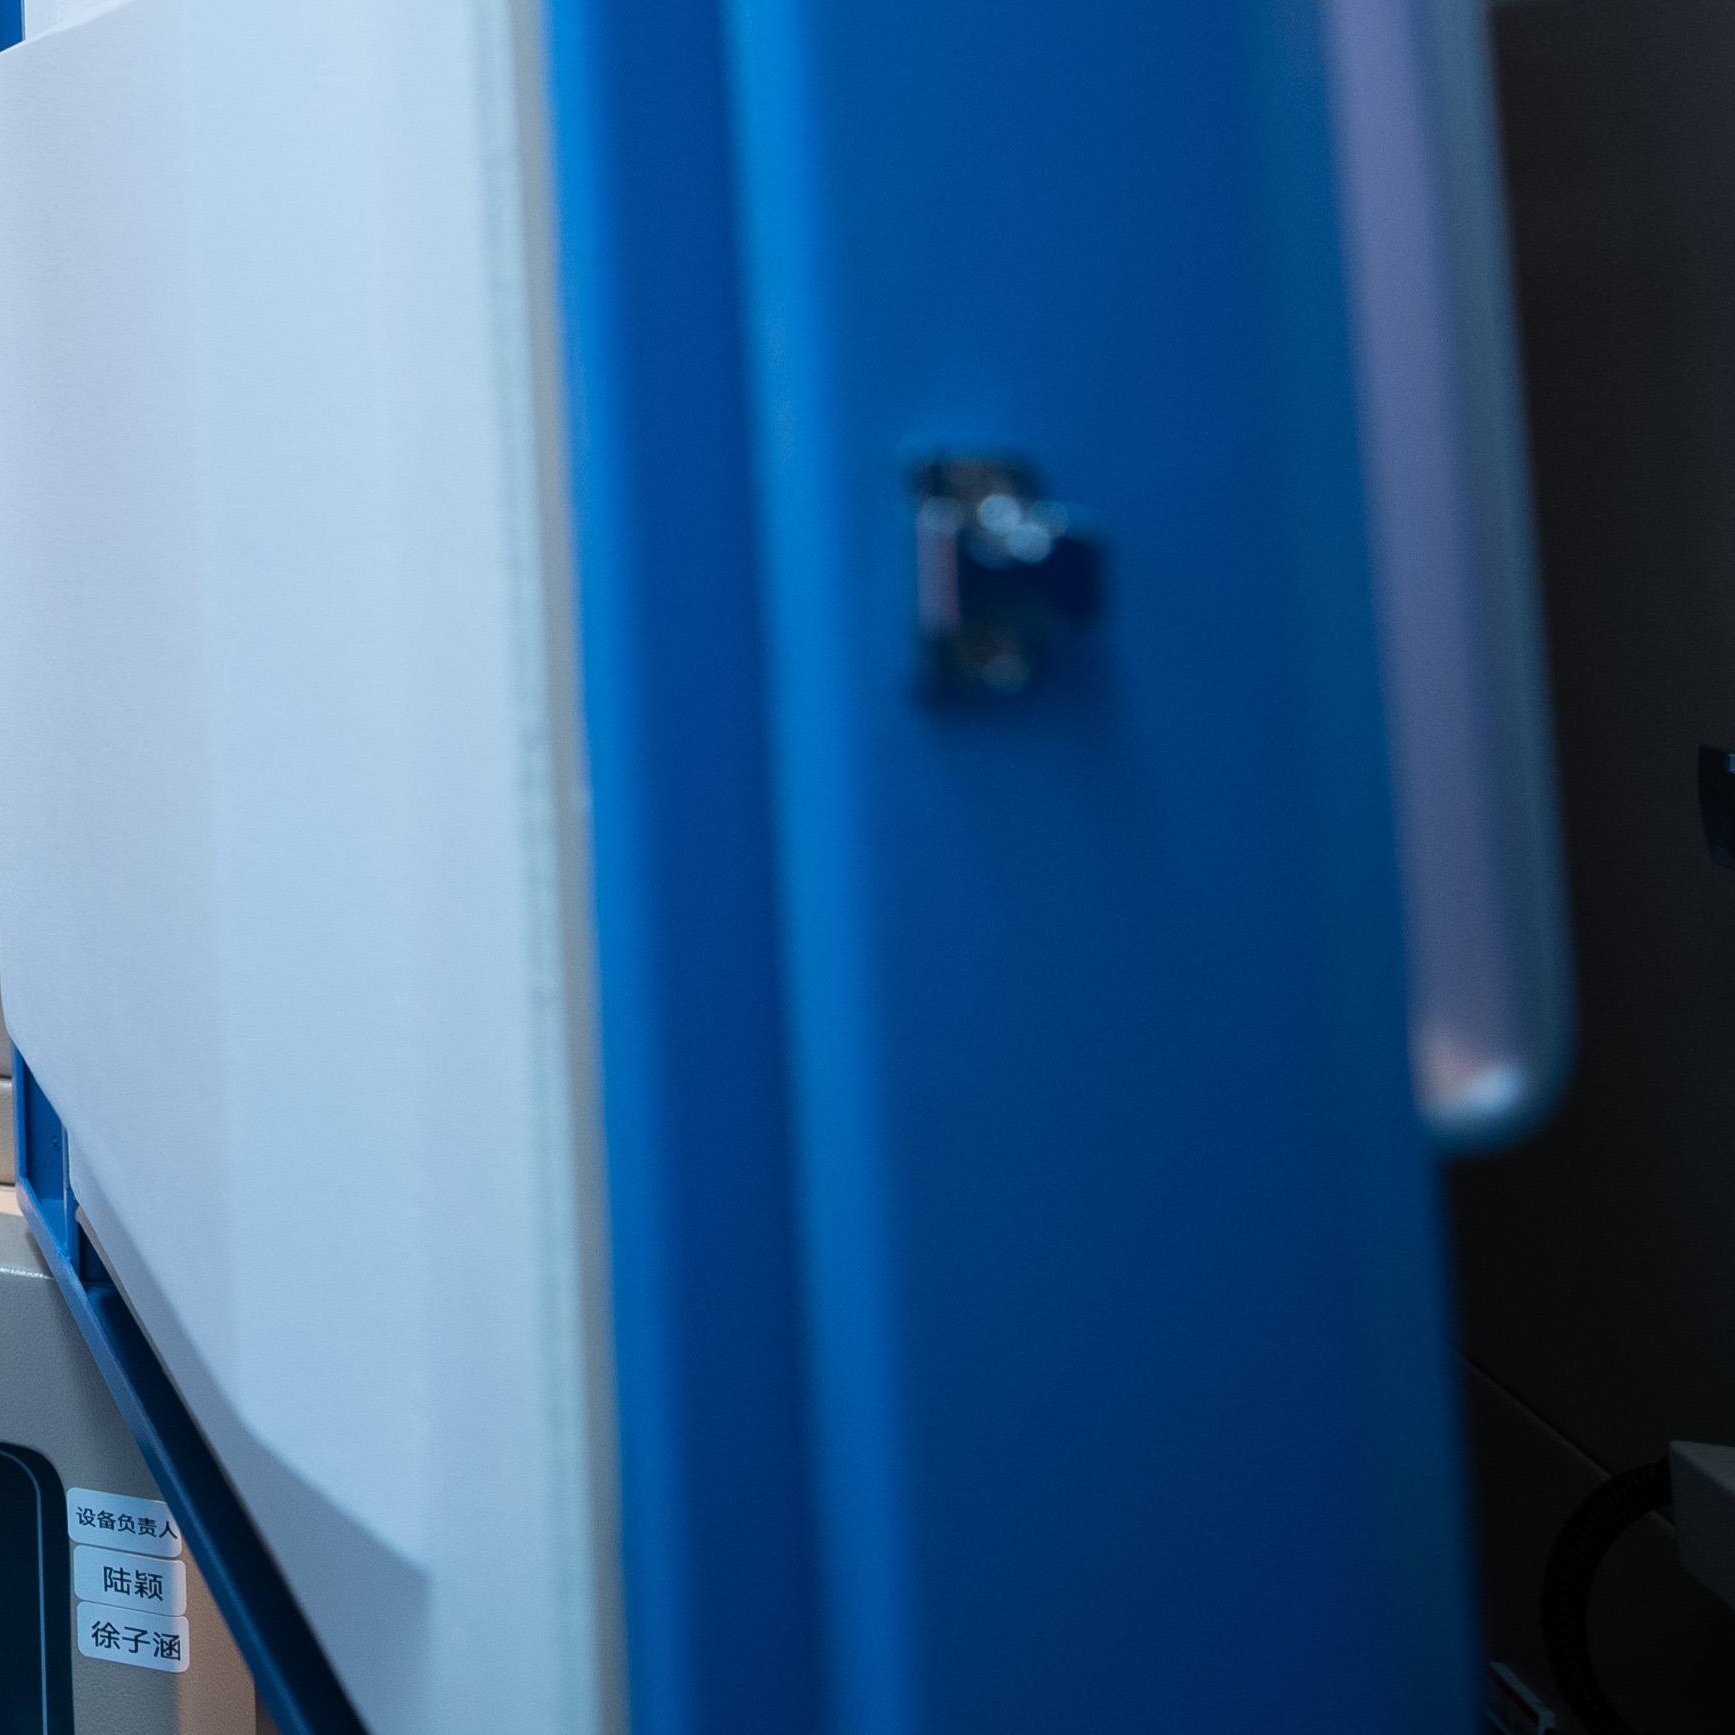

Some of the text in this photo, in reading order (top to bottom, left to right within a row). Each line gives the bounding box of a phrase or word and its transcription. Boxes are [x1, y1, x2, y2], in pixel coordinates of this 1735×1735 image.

[76, 1506, 179, 1540] 设备负责人
[103, 1566, 164, 1602] 陆颖
[91, 1620, 182, 1662] 徐子涵
